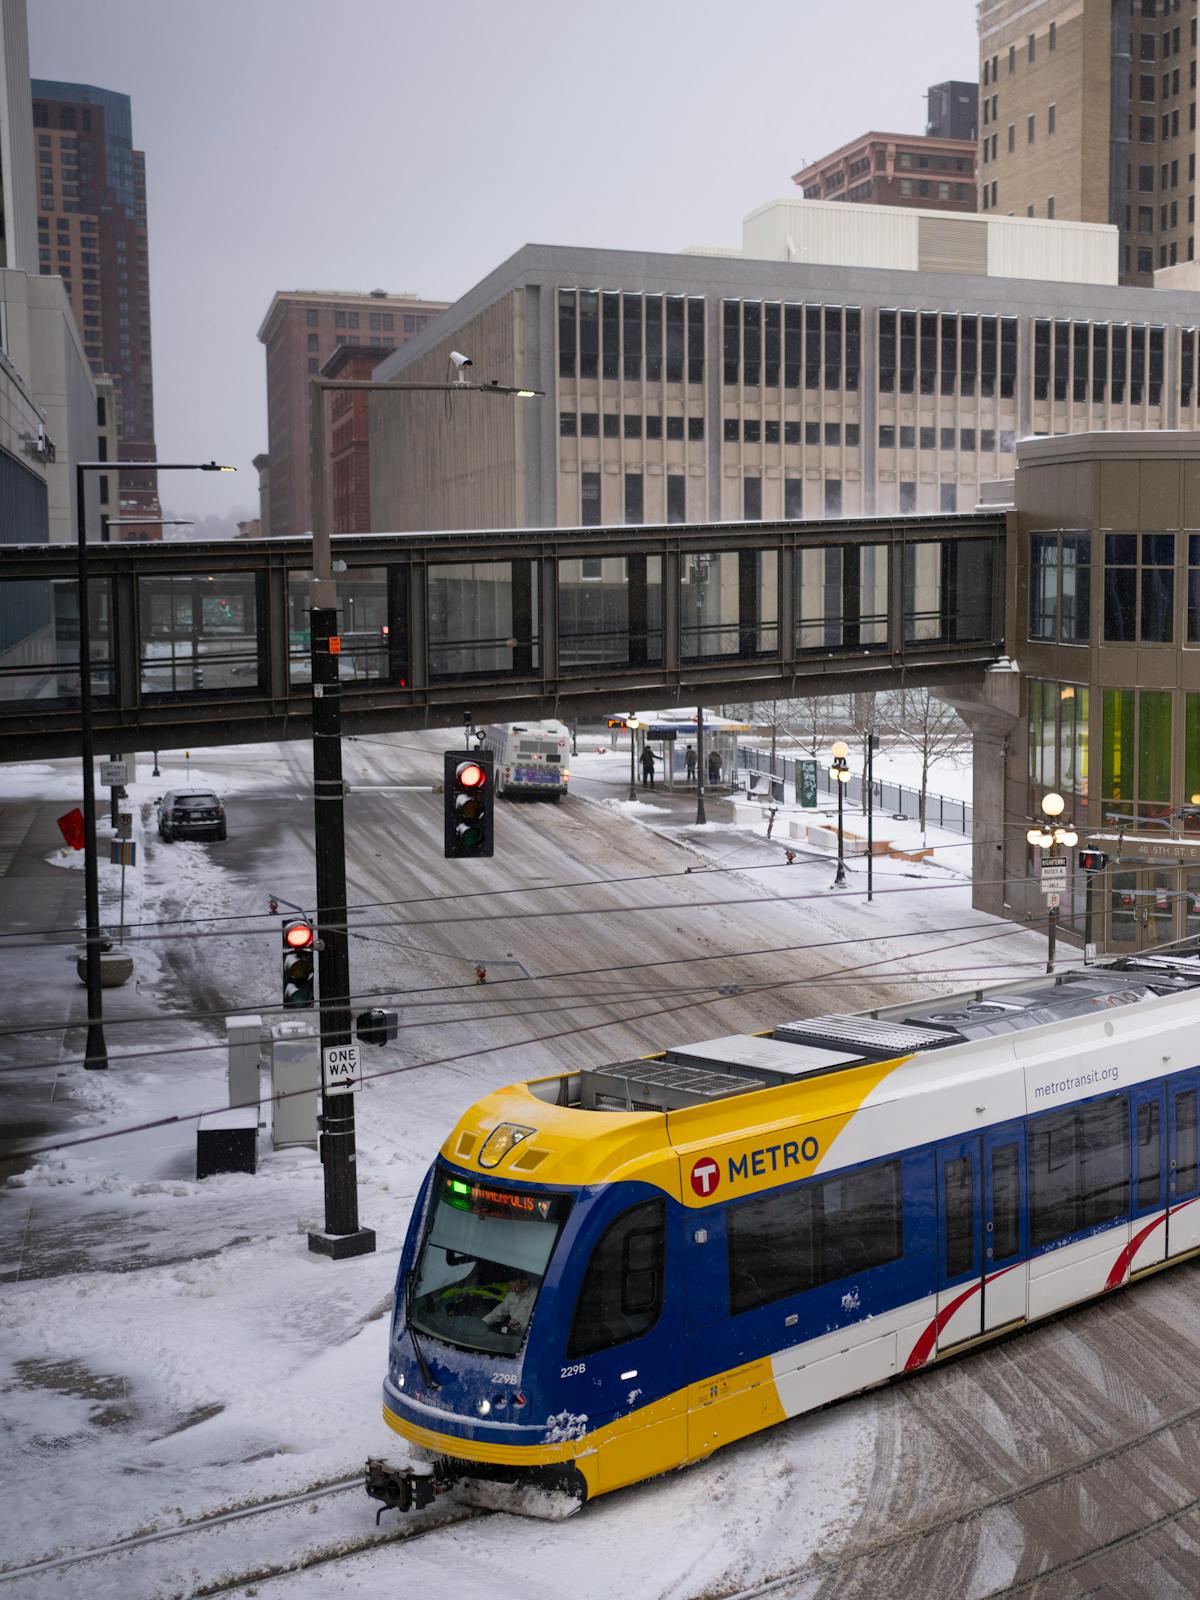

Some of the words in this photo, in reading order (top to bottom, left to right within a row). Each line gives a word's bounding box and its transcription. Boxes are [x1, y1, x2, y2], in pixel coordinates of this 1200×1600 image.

[1152, 846, 1170, 855] 5TH
[1190, 848, 1197, 857] E
[329, 1049, 356, 1062] ONE
[329, 1062, 357, 1076] WAY
[1034, 1066, 1119, 1098] metrotransit.org
[693, 1162, 717, 1194] T
[728, 1136, 819, 1183] METRO
